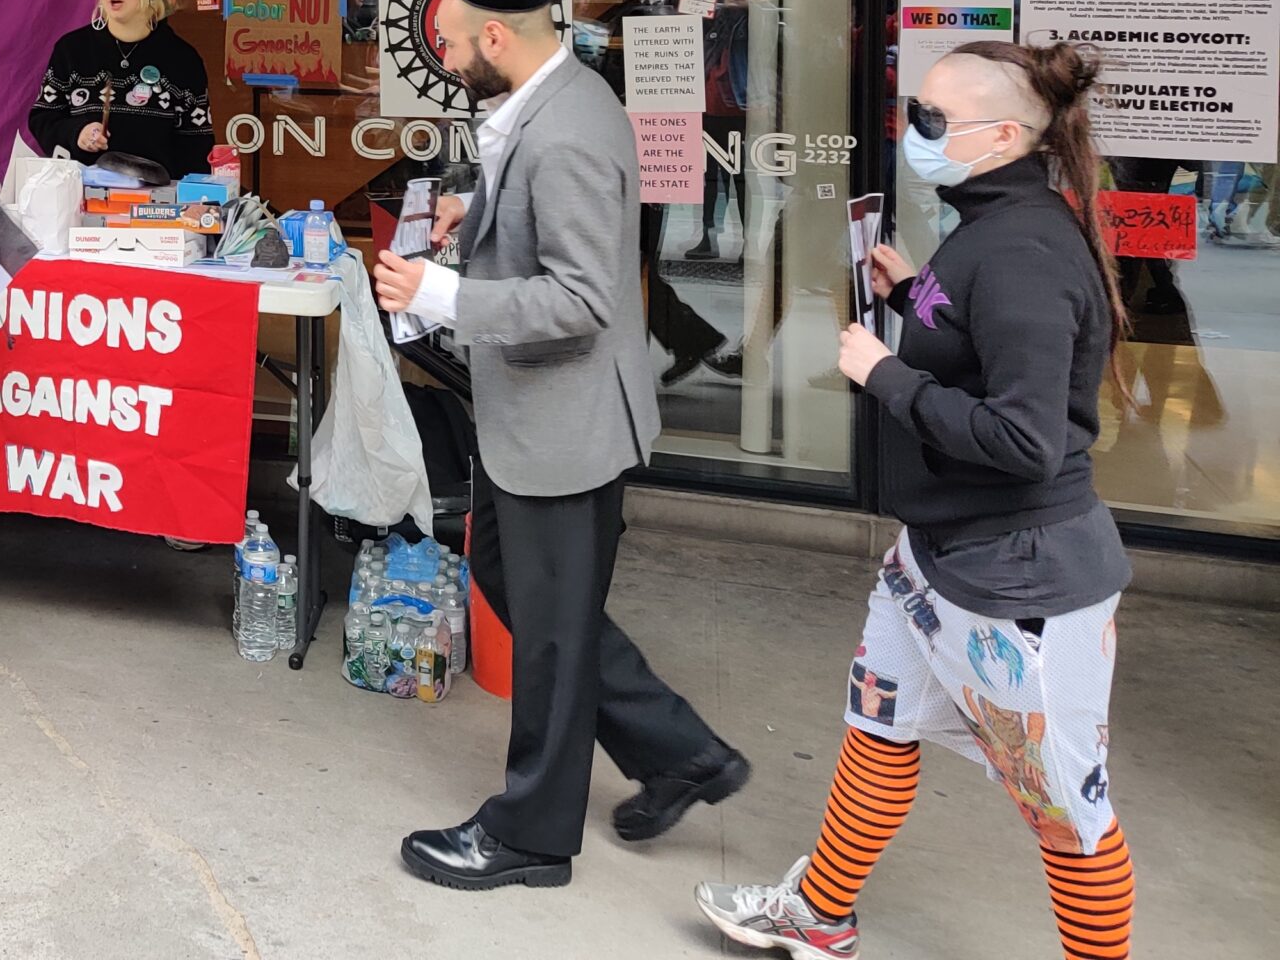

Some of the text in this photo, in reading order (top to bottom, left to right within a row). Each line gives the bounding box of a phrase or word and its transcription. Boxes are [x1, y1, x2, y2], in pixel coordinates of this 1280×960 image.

[911, 12, 1001, 27] WE DO THAT.
[633, 25, 694, 35] THE EARTH IS
[231, 27, 322, 56] Genocide
[672, 38, 694, 46] WITH
[1049, 30, 1251, 46] 3. ACADEMIC BOYCOTT:
[634, 51, 649, 59] THE
[683, 50, 695, 58] OF
[634, 63, 669, 71] EMPIRES
[675, 75, 696, 83] THEY
[635, 87, 696, 96] WERE ETERNAL
[1194, 86, 1218, 98] TO
[1149, 100, 1234, 114] ELECTION
[639, 118, 687, 127] THE ONES
[225, 113, 327, 158] ON
[640, 133, 685, 142] WE LOVE
[805, 134, 858, 150] LCOD
[643, 149, 684, 158] ARE THE
[804, 149, 851, 165] 2232
[640, 164, 693, 173] NEMIES OF
[659, 180, 689, 189] STATE
[138, 207, 176, 218] BUILDERS
[5, 443, 124, 513] WAR
